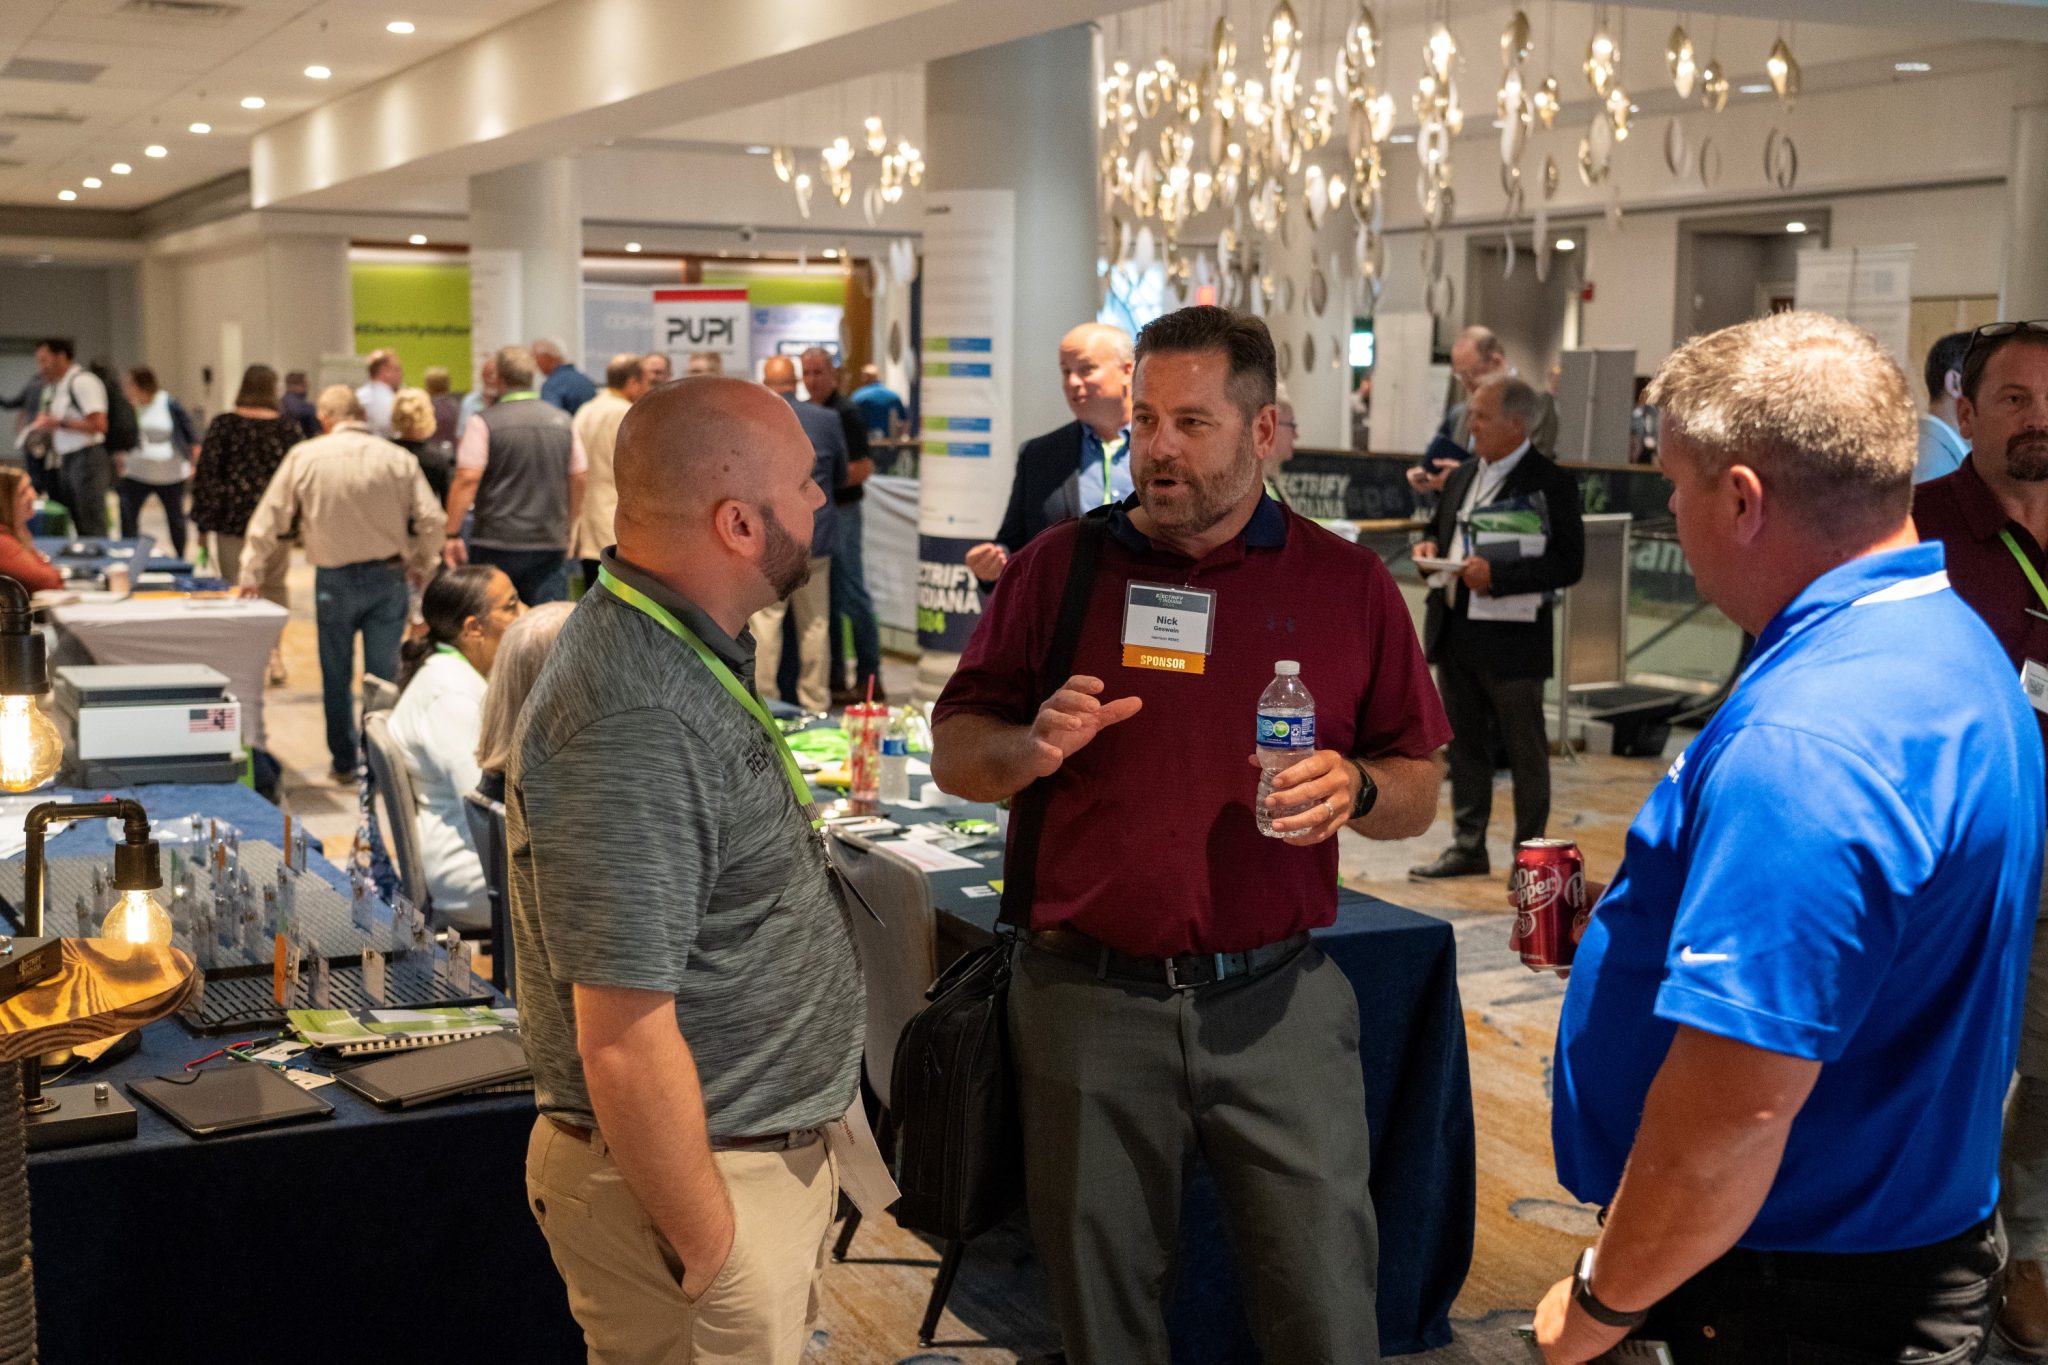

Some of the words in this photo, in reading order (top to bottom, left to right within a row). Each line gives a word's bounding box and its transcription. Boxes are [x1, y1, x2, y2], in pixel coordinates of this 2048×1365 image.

[666, 317, 734, 345] PUPI
[1156, 615, 1178, 626] Nick
[1140, 654, 1186, 670] SPONSOR
